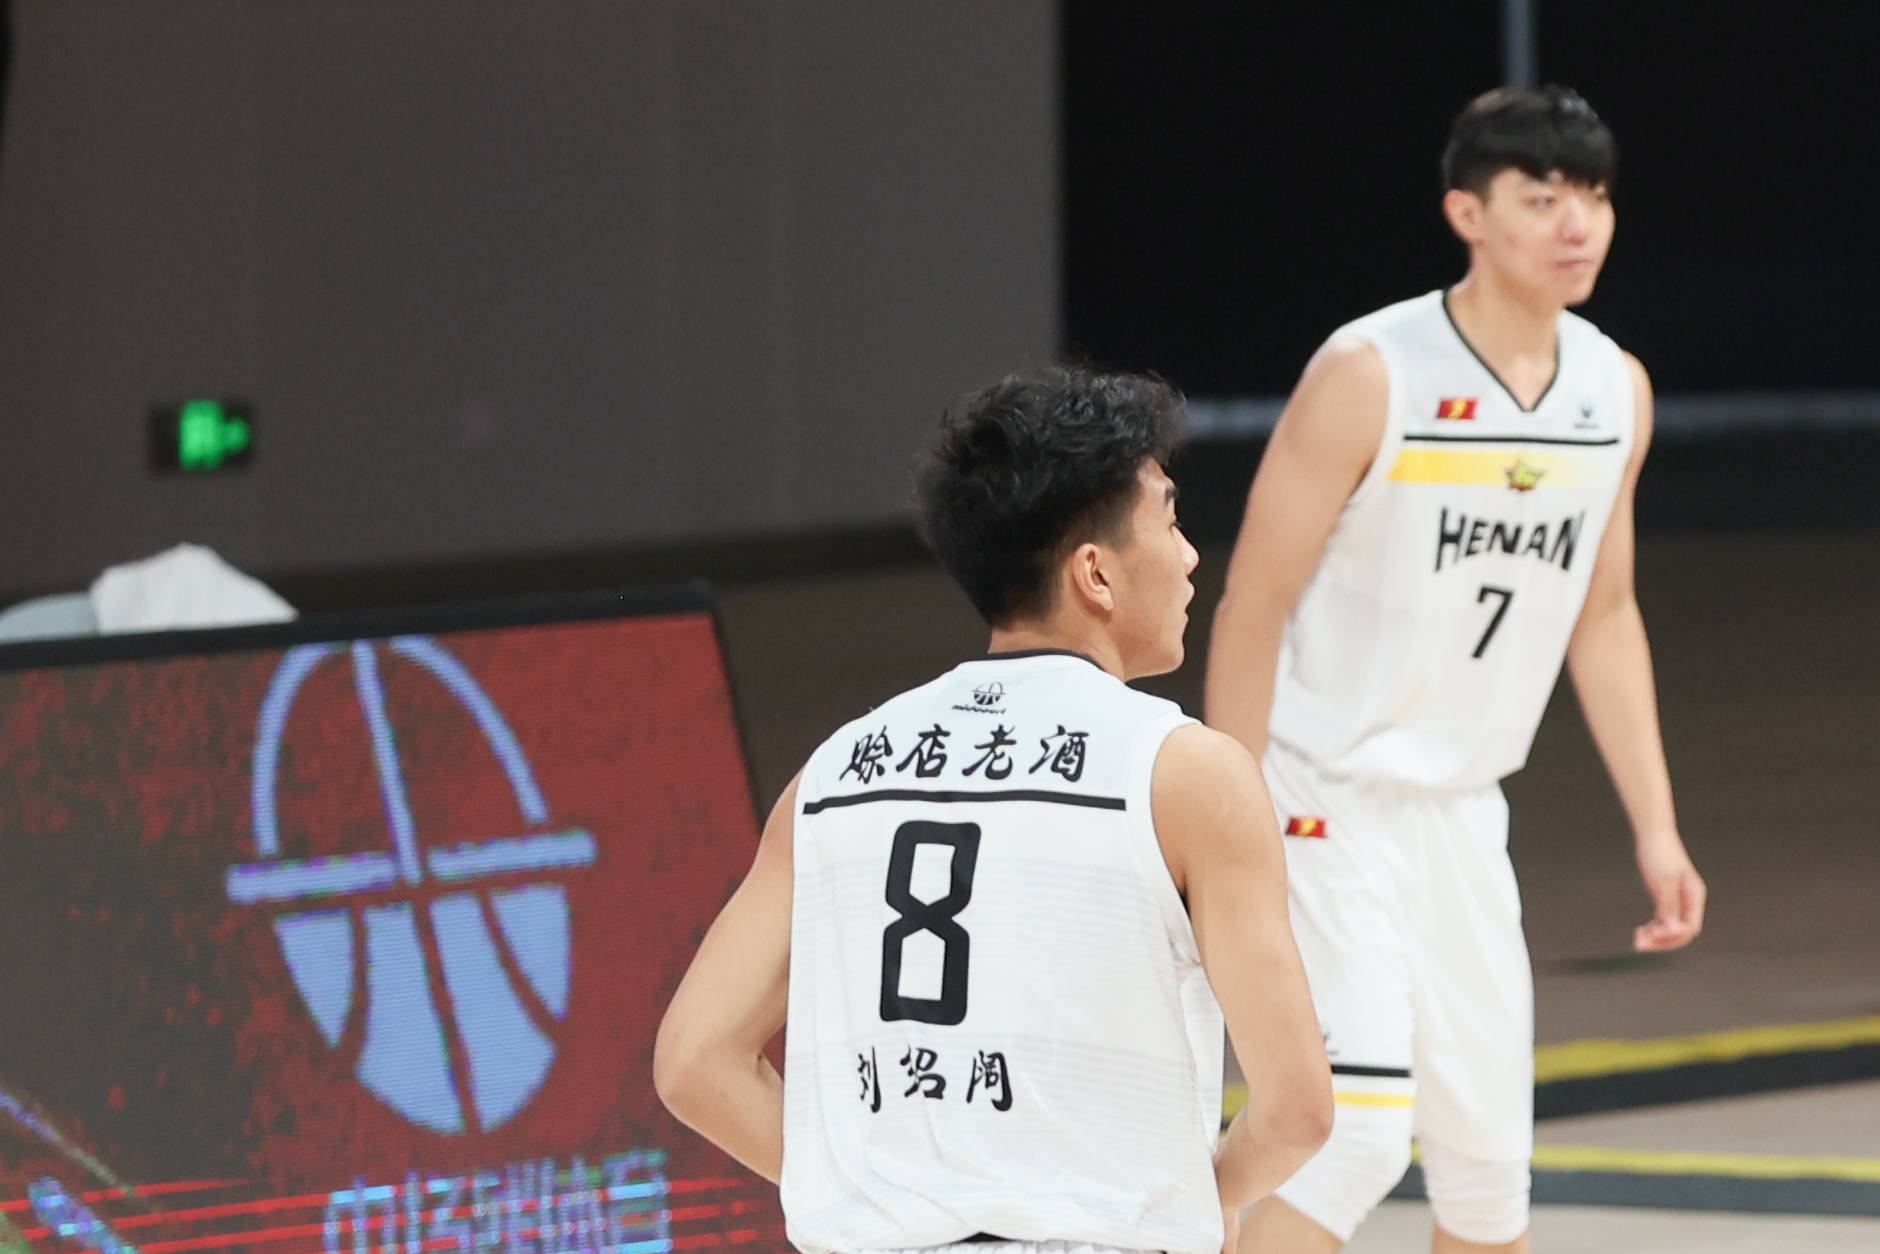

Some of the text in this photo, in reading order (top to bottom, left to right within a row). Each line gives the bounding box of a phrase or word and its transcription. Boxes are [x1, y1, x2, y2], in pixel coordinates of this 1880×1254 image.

[1434, 506, 1584, 573] HENAN
[1471, 582, 1514, 659] 7
[839, 723, 1091, 785] 赊店老酒
[880, 820, 982, 1026] 8
